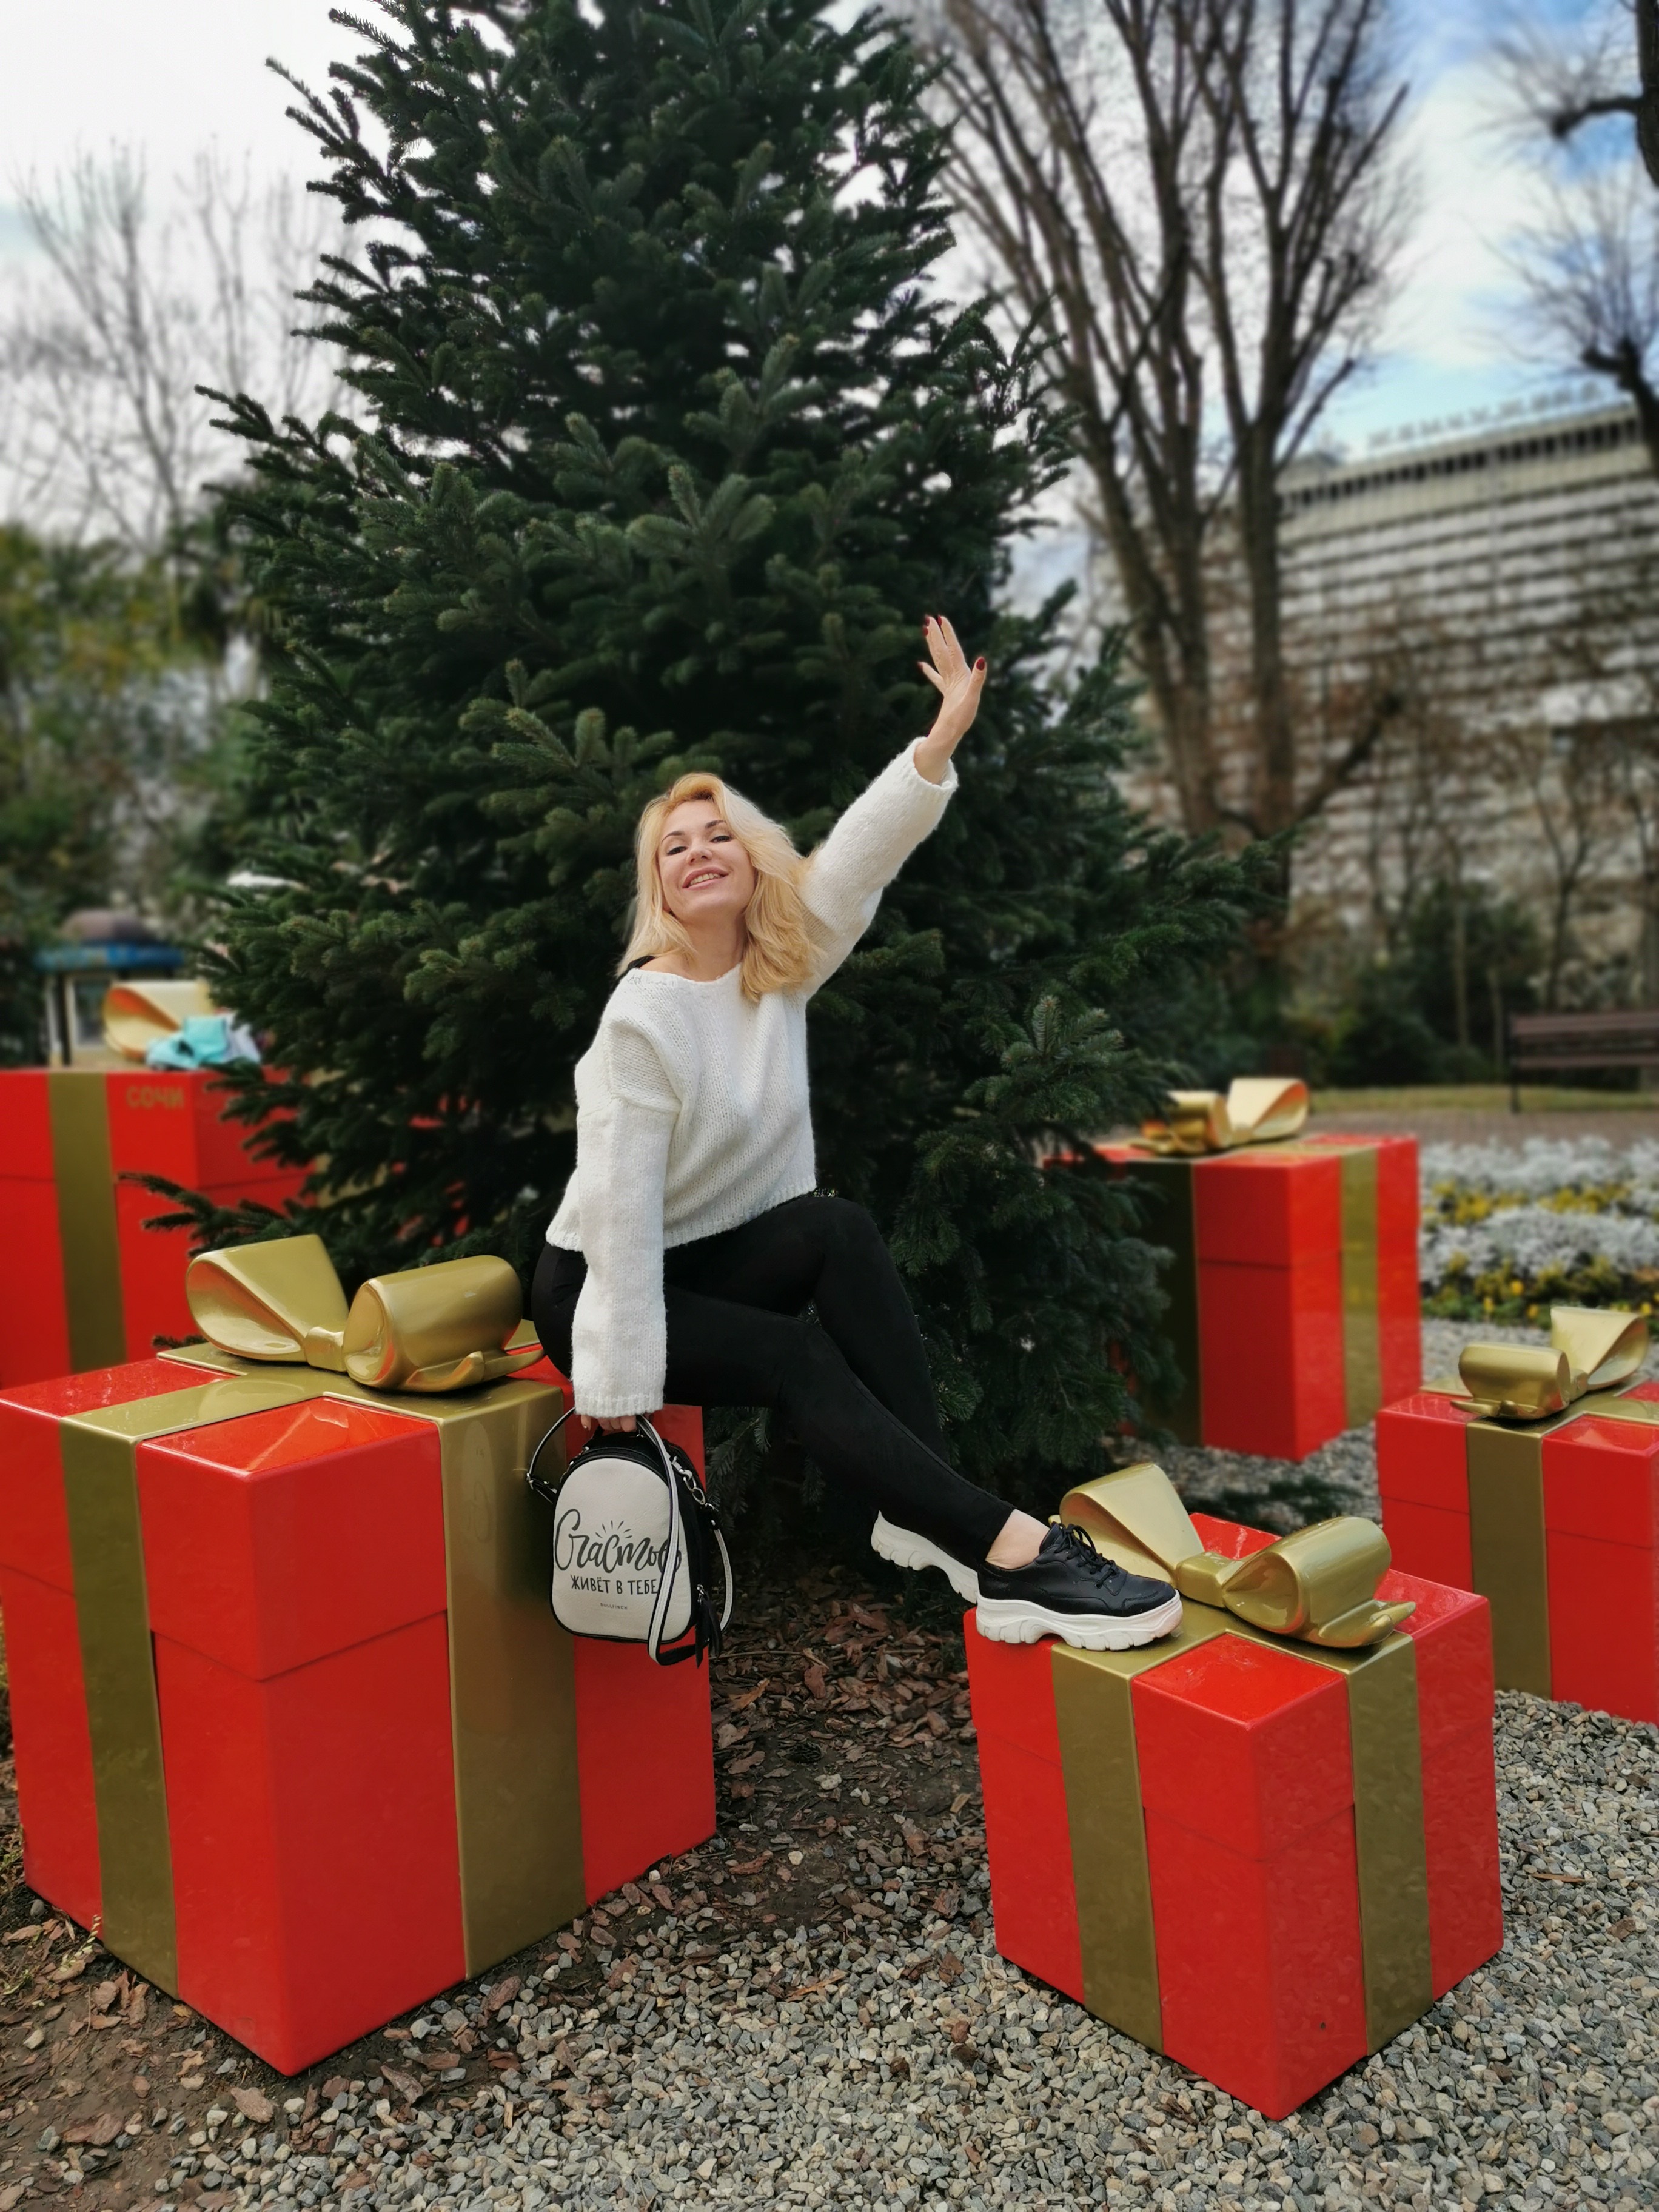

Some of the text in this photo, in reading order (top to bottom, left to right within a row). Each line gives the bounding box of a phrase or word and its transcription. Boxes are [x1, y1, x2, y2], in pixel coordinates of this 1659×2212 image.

[126, 1086, 184, 1109] СОЧИ
[570, 1575, 658, 1595] ЖИВЁТ В ТЕБЕ
